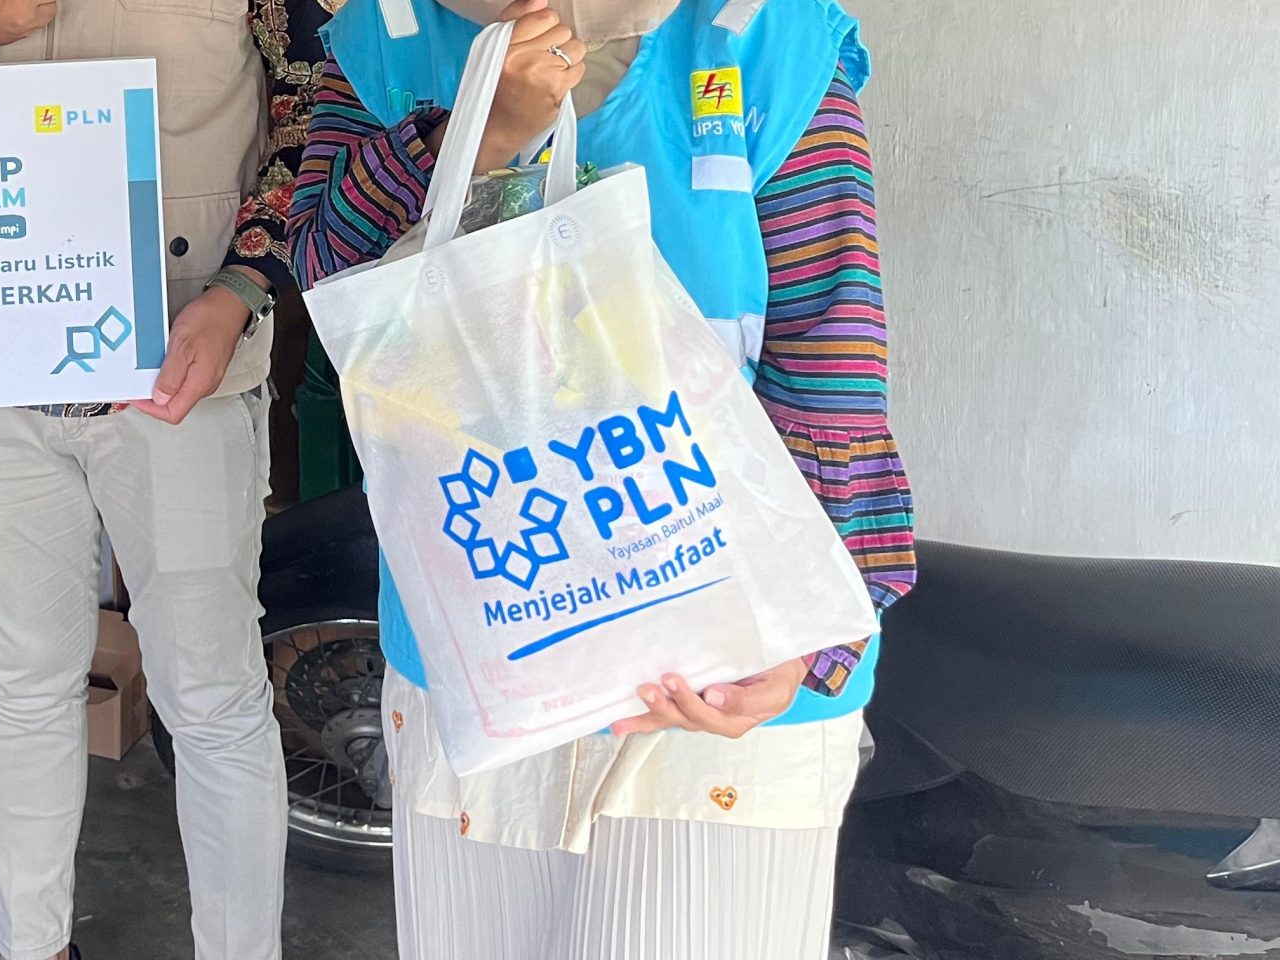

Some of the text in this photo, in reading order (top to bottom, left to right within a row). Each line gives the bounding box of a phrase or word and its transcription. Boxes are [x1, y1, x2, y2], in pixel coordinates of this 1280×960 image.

[66, 109, 112, 125] PLN
[693, 120, 723, 138] UP3
[45, 251, 116, 271] Listrik
[548, 390, 692, 481] YBM
[583, 442, 717, 540] PLN
[607, 492, 724, 559] Yayasan Baitul Maal
[483, 526, 727, 626] Menjejak Manfaat
